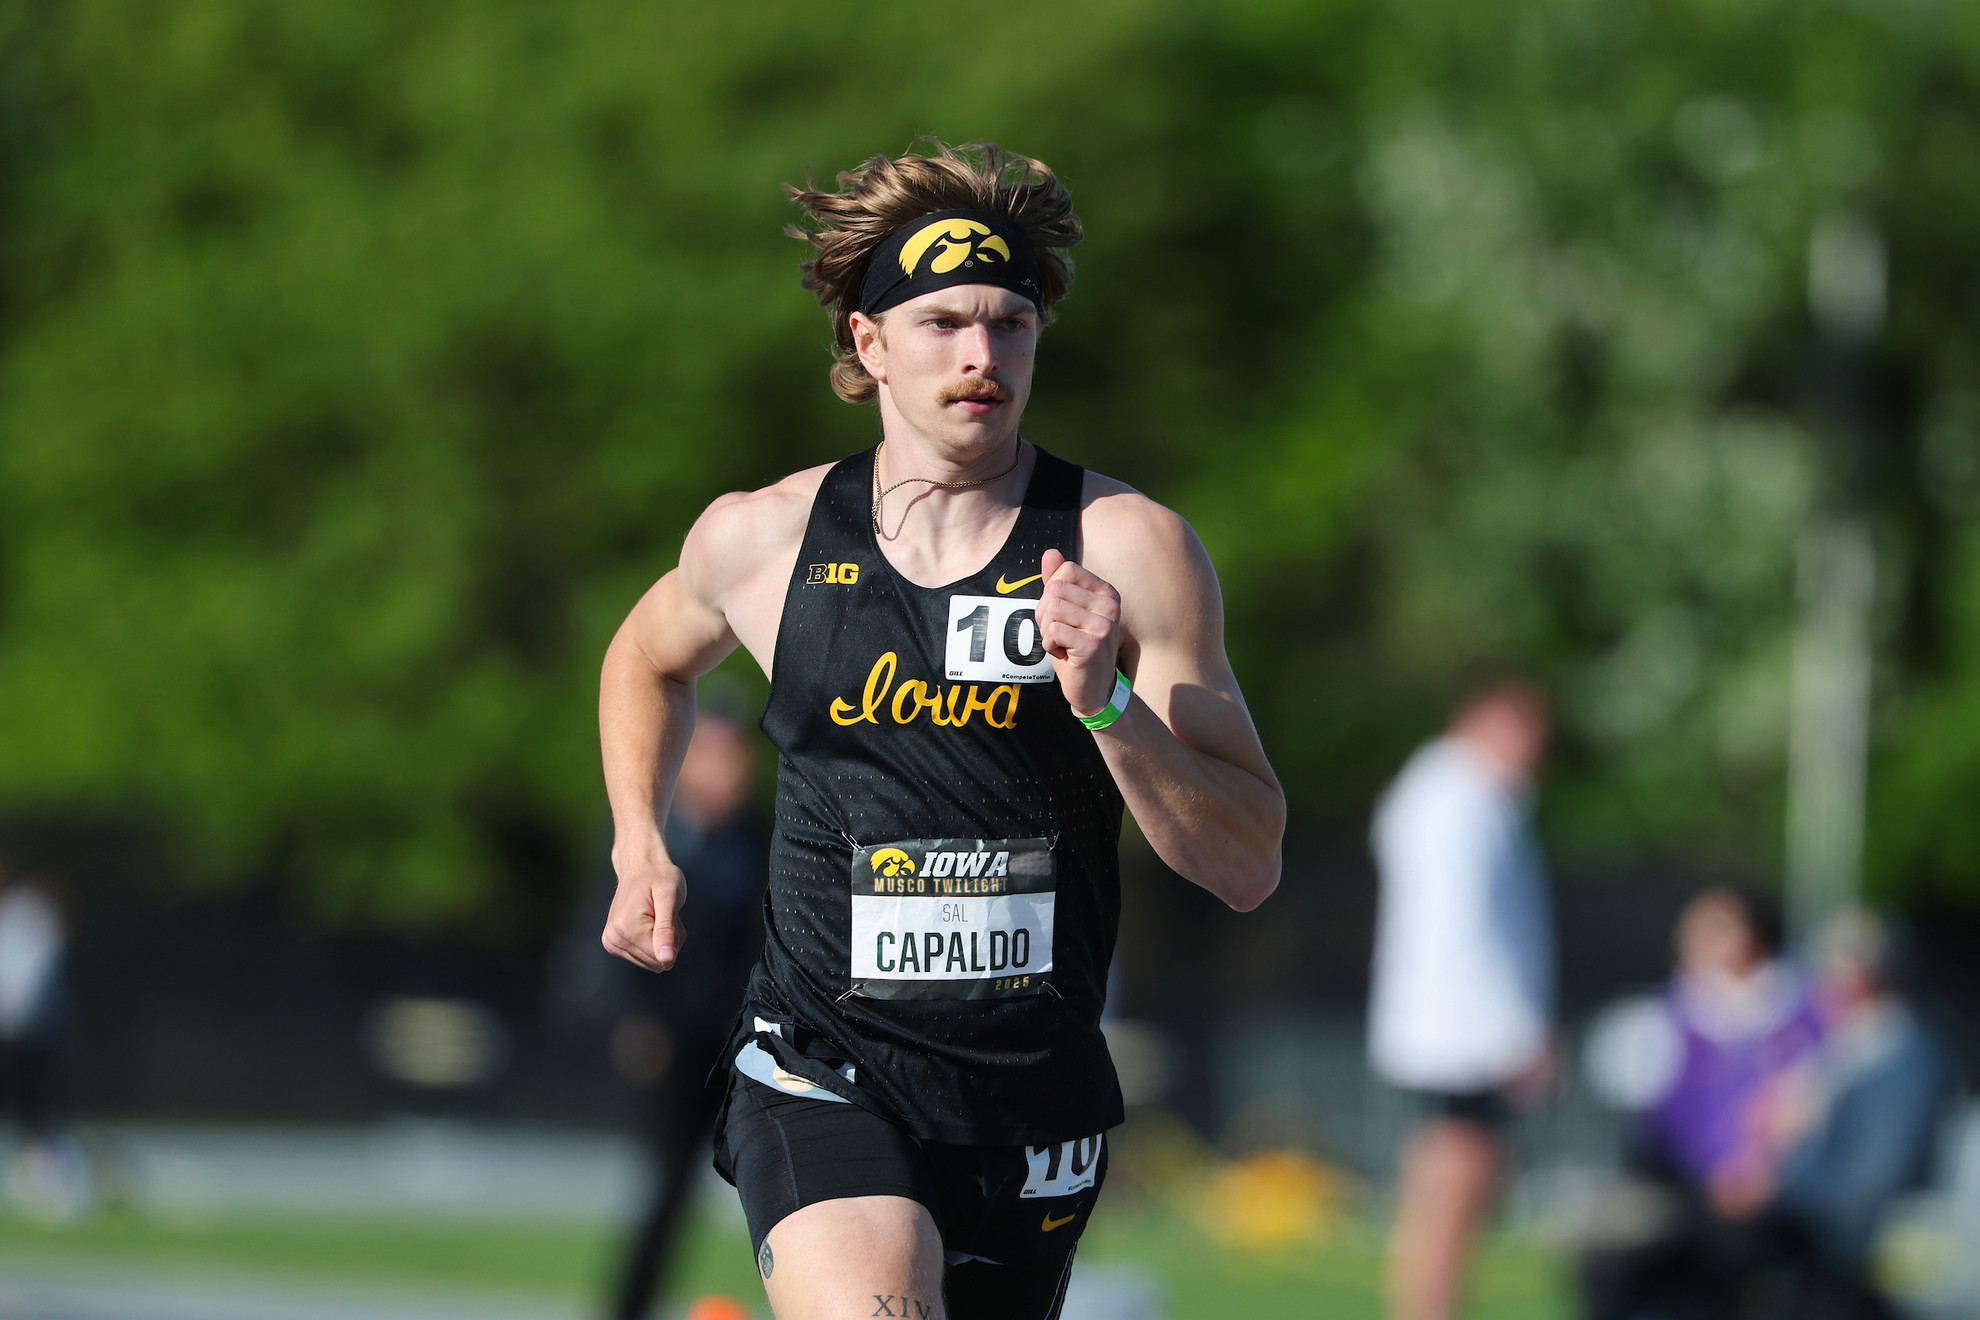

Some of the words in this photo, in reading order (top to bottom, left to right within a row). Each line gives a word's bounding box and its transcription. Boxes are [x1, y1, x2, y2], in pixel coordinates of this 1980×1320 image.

[956, 605, 1048, 667] 10
[829, 651, 1023, 729] Iowa
[918, 851, 1010, 878] IOWA
[874, 877, 925, 893] MUSCO
[934, 877, 1008, 894] TWILIGHT
[942, 903, 968, 923] SAL
[876, 928, 1030, 973] CAPALDO
[872, 1294, 931, 1320] XIV
